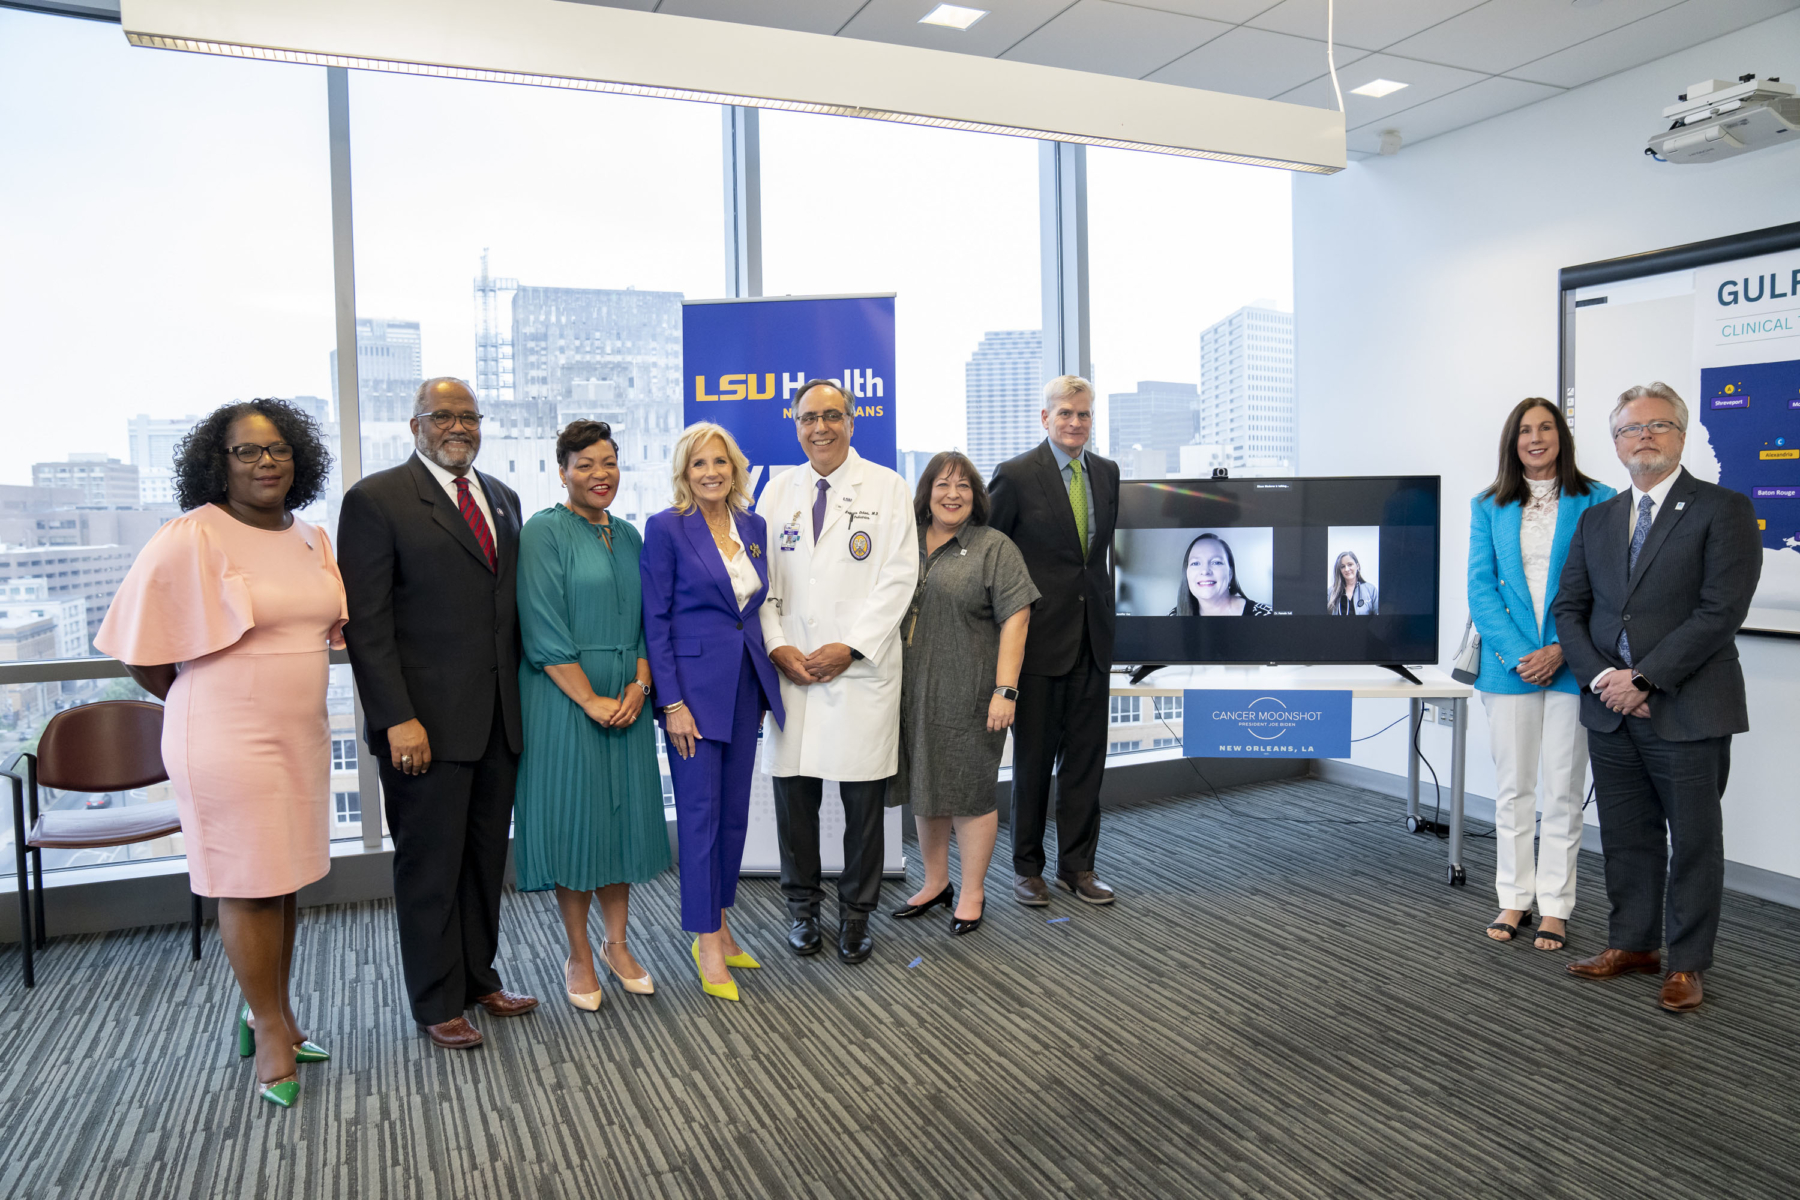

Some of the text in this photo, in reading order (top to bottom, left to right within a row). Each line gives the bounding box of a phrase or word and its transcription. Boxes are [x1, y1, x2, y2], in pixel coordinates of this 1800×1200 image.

[1721, 317, 1793, 337] CLINICAL
[695, 368, 884, 401] LSU Hlth
[1715, 399, 1743, 407] Shreveport
[1212, 711, 1322, 721] CANCER MOONSHOT
[1245, 745, 1298, 753] ORLEANS,
